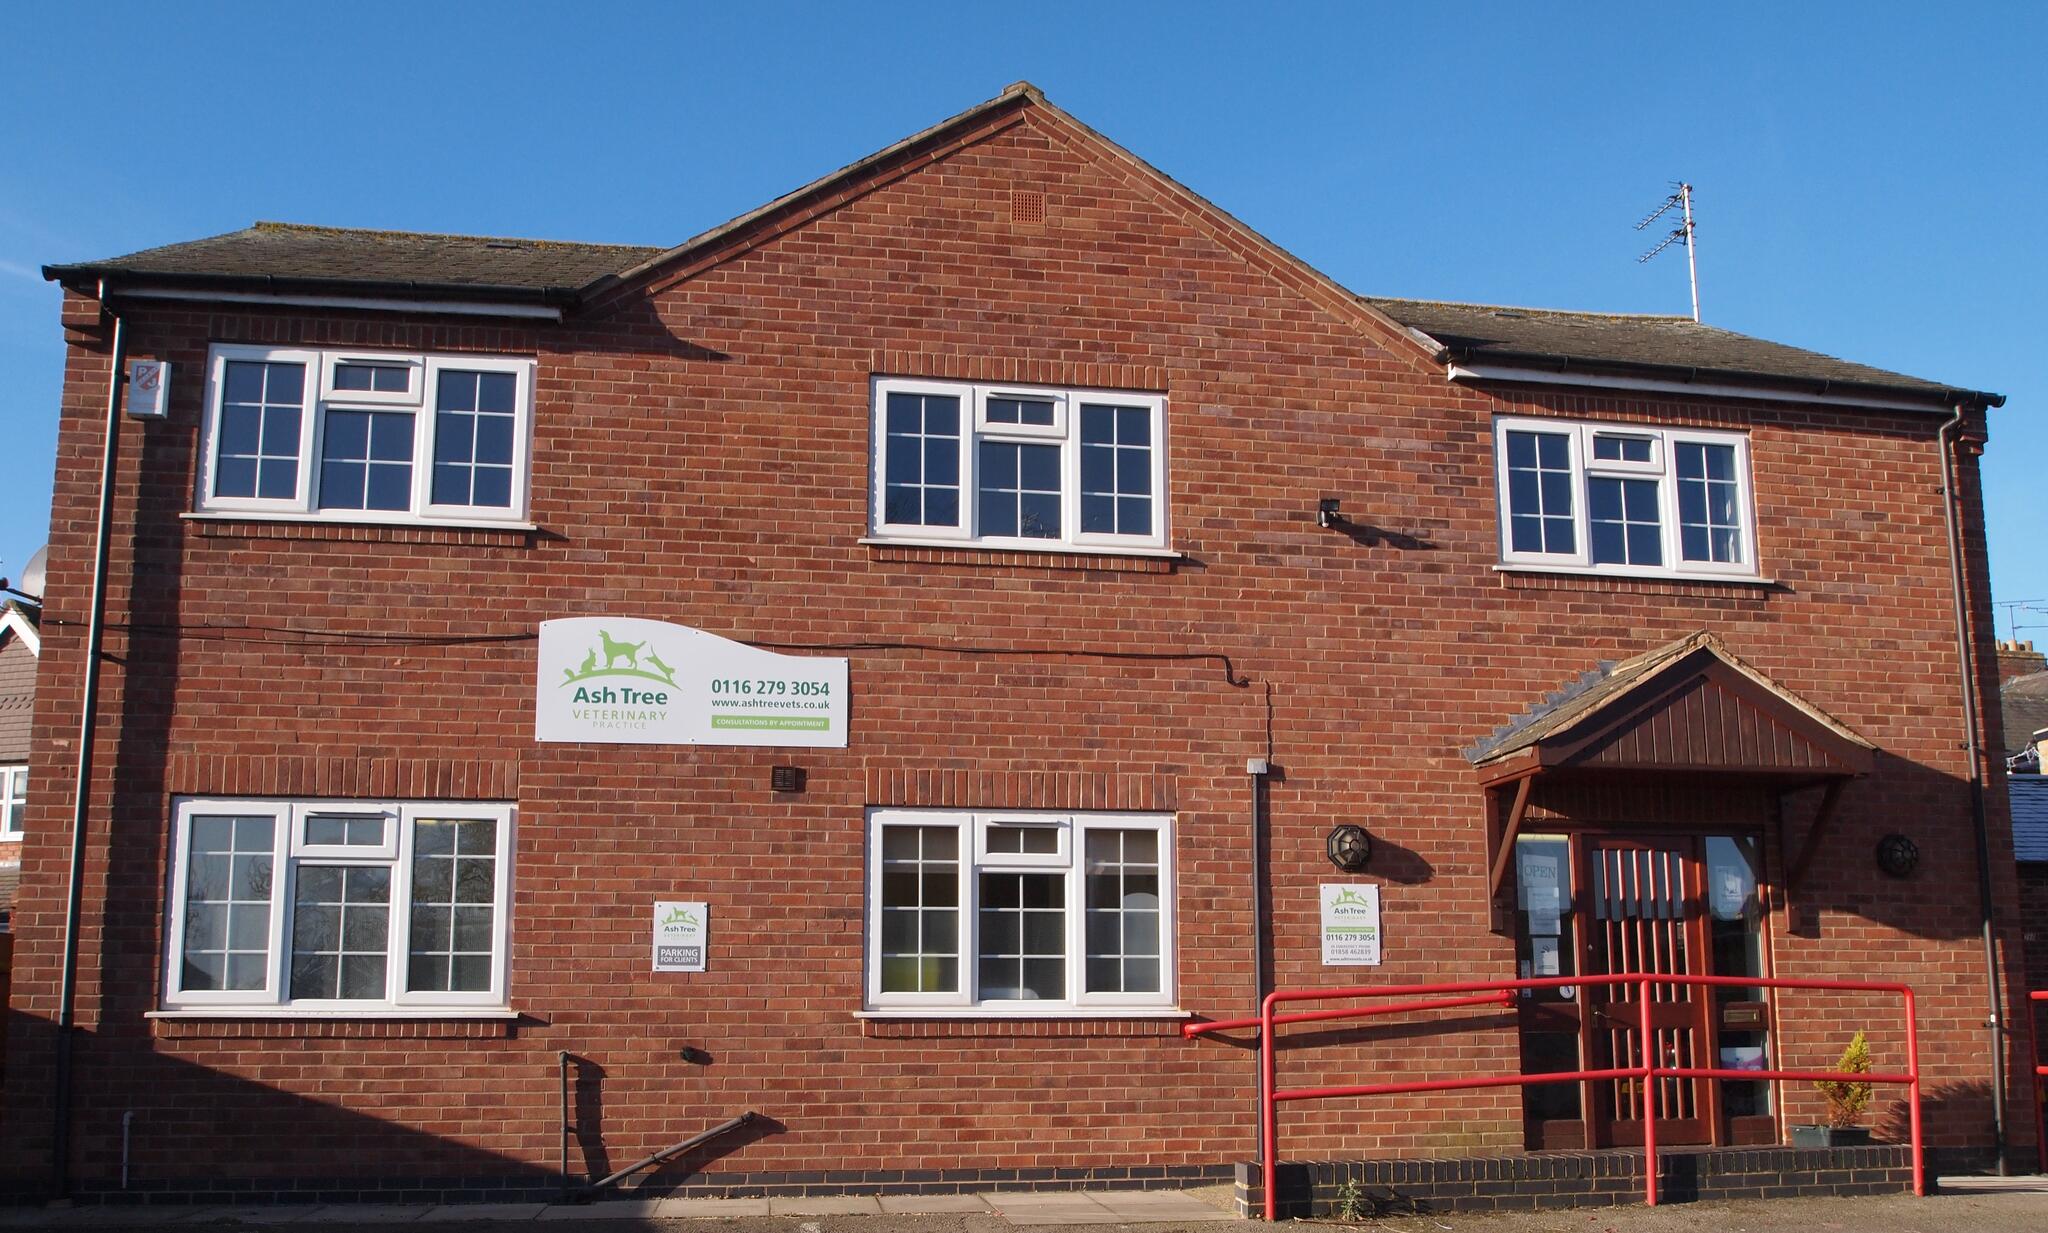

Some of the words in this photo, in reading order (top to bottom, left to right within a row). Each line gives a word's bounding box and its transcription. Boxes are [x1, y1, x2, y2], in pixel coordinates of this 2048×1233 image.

[711, 679, 752, 694] 0116
[756, 680, 786, 695] 279
[790, 681, 830, 696] 3054
[573, 686, 617, 704] Ash
[620, 687, 669, 705] Tree
[711, 698, 830, 710] www.ashtreevets.co.uk
[572, 709, 668, 721] VETERINARY
[592, 721, 647, 730] PRACTICE
[716, 718, 768, 727] CONSULTATIONS
[769, 719, 778, 727] BY
[779, 719, 825, 728] APPOINTMENT
[1524, 864, 1556, 879] OPEN
[1326, 933, 1343, 941] 0116
[1344, 933, 1357, 941] 279
[1359, 933, 1375, 941] 3054
[660, 949, 698, 957] PARKING
